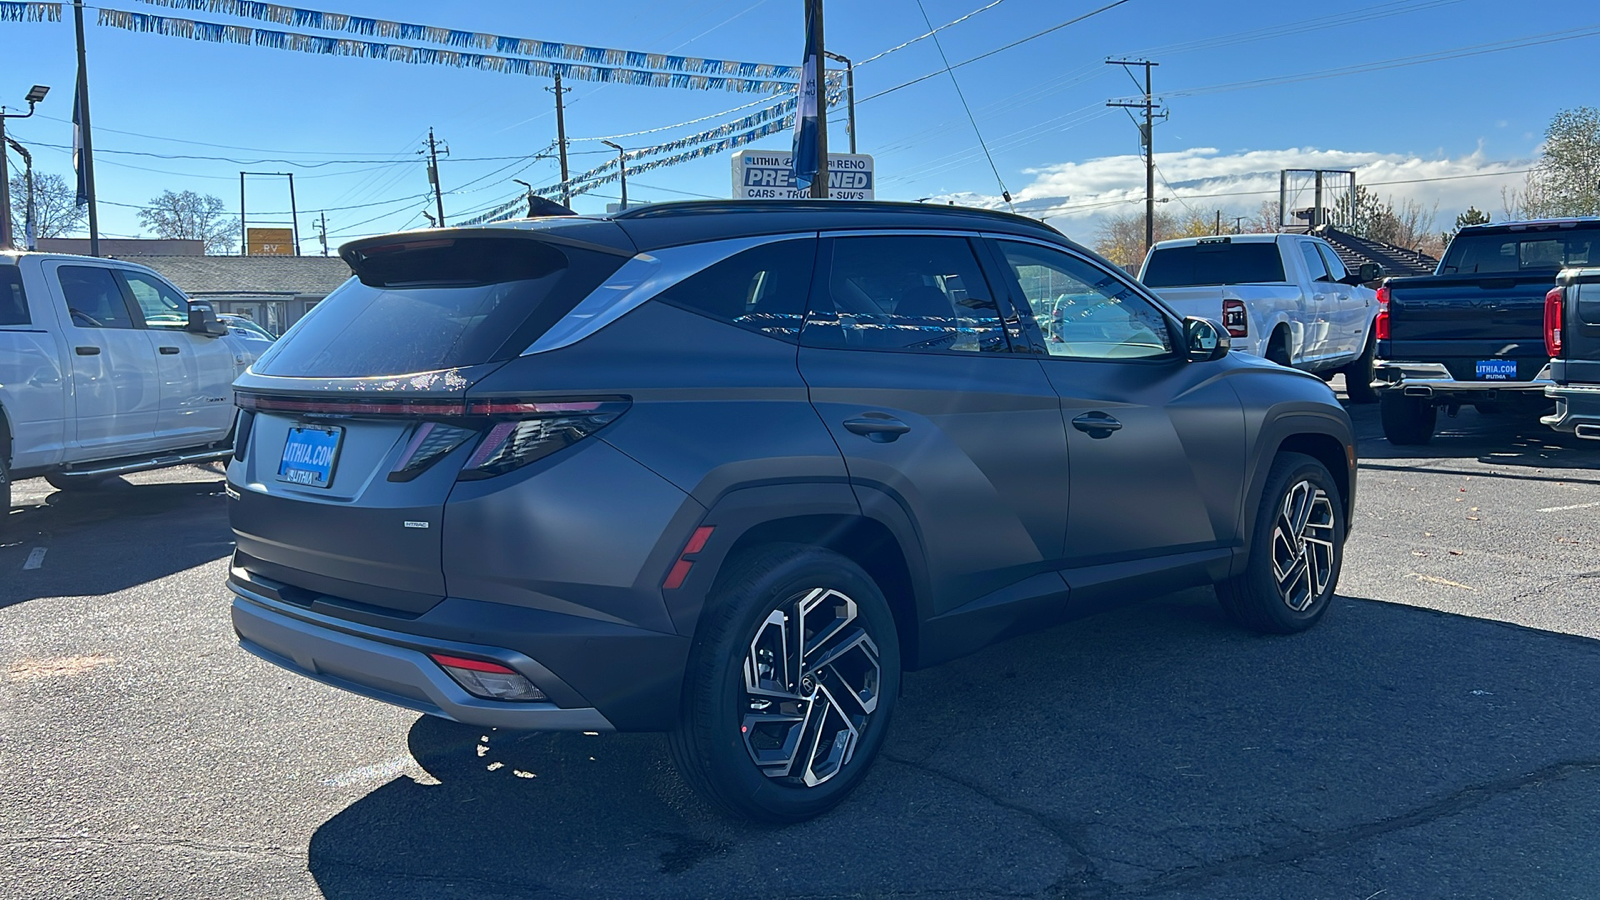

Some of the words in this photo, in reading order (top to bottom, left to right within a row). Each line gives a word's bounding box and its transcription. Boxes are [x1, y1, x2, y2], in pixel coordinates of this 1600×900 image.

[752, 157, 780, 166] LITHIA
[837, 160, 865, 169] RENO
[748, 189, 775, 198] CARS
[836, 191, 864, 199] SUV'S
[263, 244, 278, 252] RV
[1475, 365, 1516, 373] LITHIA.COM
[283, 442, 335, 467] LITHIA.COM
[293, 469, 313, 484] LITHIA
